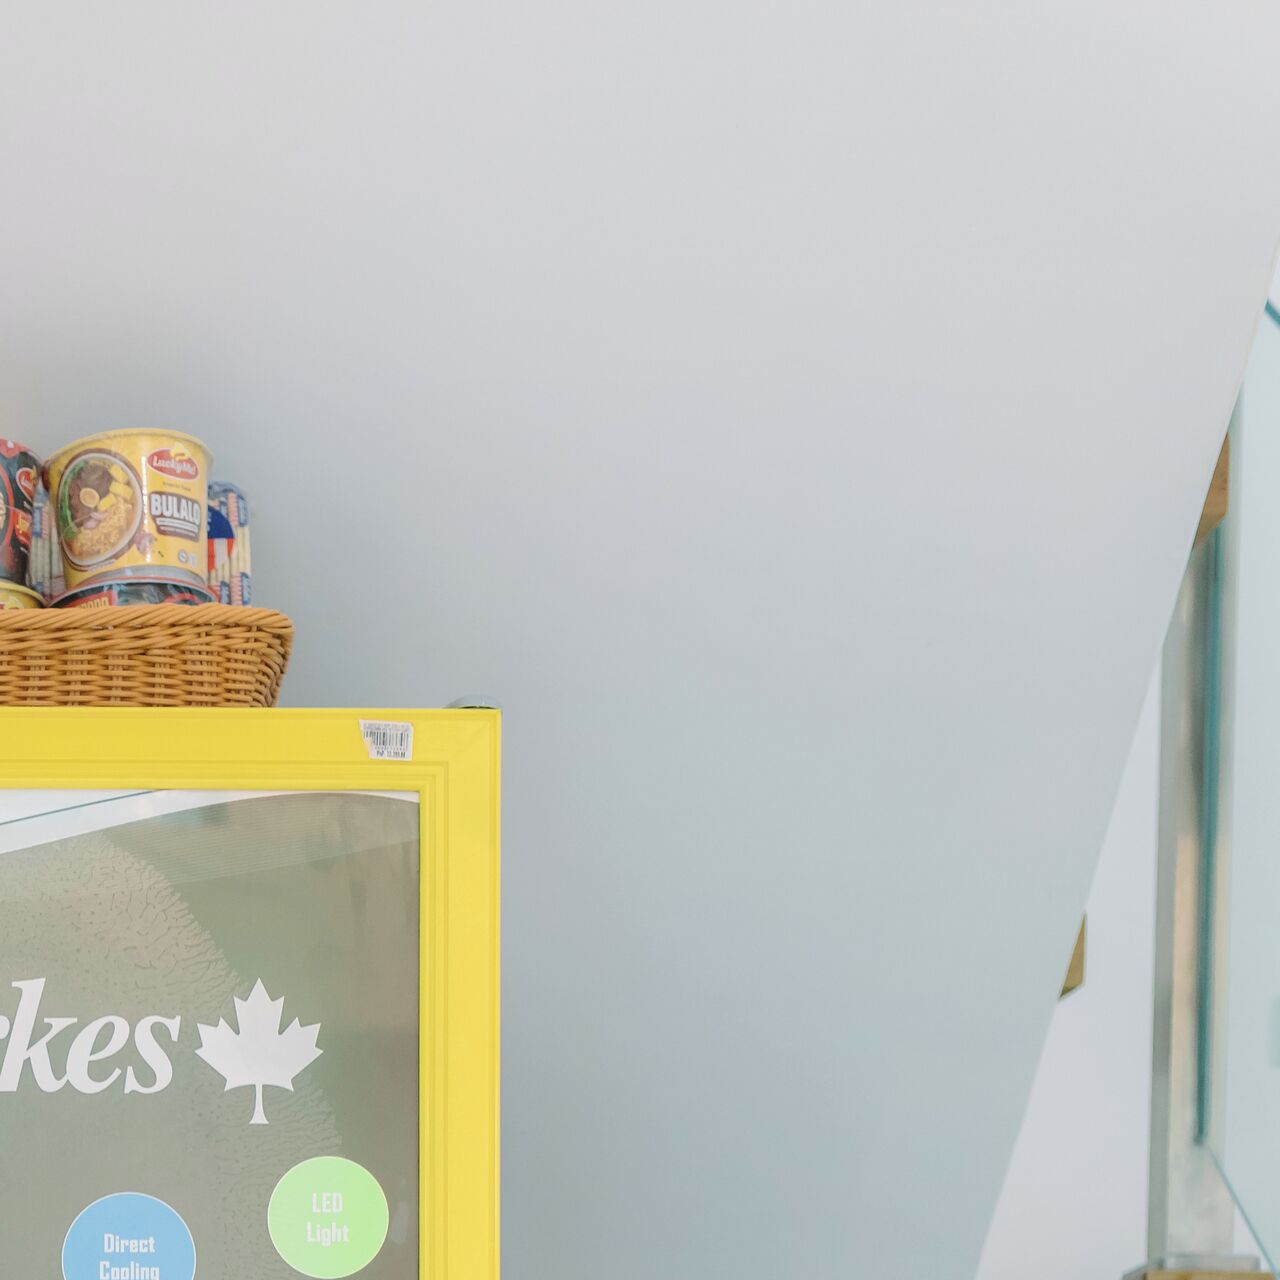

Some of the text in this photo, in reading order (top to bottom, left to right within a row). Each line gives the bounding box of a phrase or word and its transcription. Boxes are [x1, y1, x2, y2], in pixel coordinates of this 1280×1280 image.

[150, 493, 201, 526] BULALO
[311, 1192, 344, 1214] LED
[103, 1233, 156, 1253] Direct
[306, 1222, 350, 1247] Light
